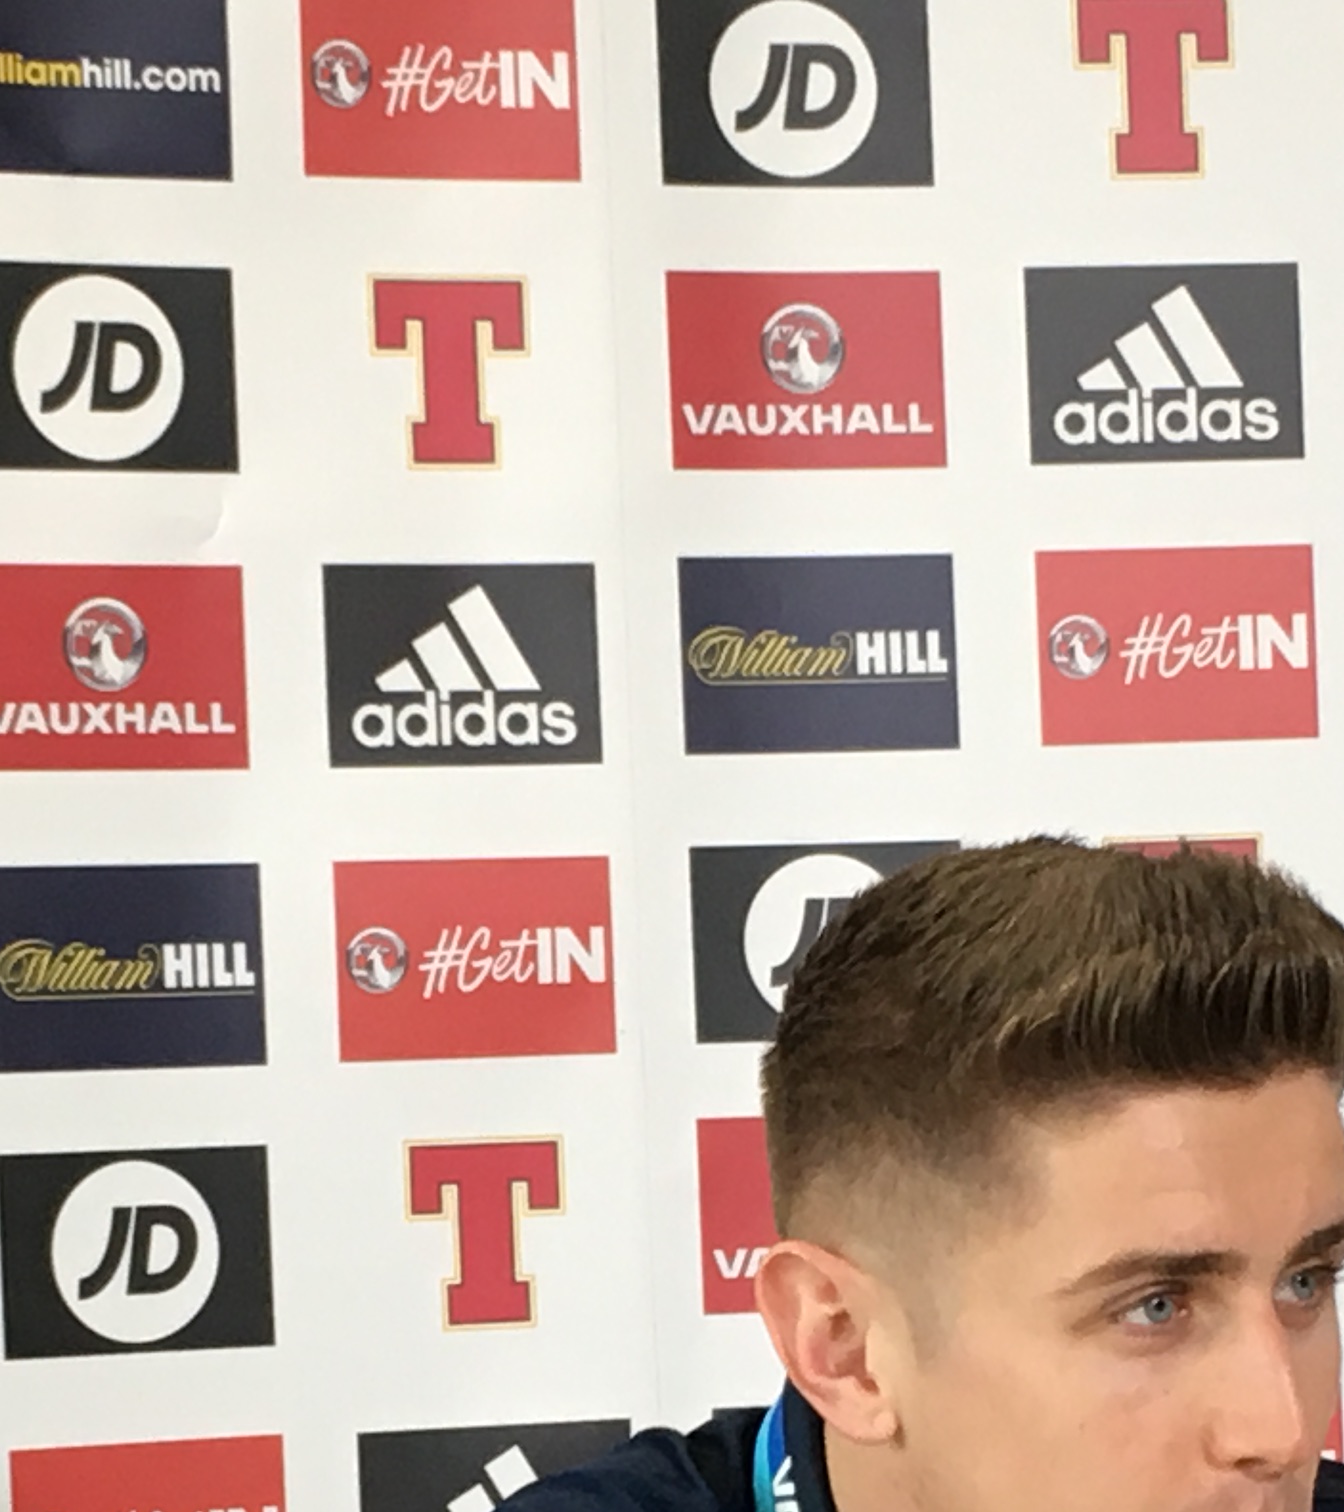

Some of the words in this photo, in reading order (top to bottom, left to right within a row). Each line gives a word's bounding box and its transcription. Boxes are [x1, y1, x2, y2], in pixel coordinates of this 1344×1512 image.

[382, 45, 570, 117] #GetIN
[735, 43, 856, 132] JD
[1072, 0, 1234, 180] T
[40, 321, 162, 413] JD
[367, 273, 529, 470] T
[683, 403, 933, 437] VAUXHALL
[1054, 388, 1279, 444] adidas
[688, 626, 855, 684] William
[856, 631, 948, 675] HILL
[1120, 613, 1308, 686] #GetIN
[352, 691, 577, 748] adidas
[163, 941, 255, 990] HILL
[418, 925, 606, 999] #GetIN
[78, 1204, 198, 1301] JD
[403, 1134, 566, 1331] T
